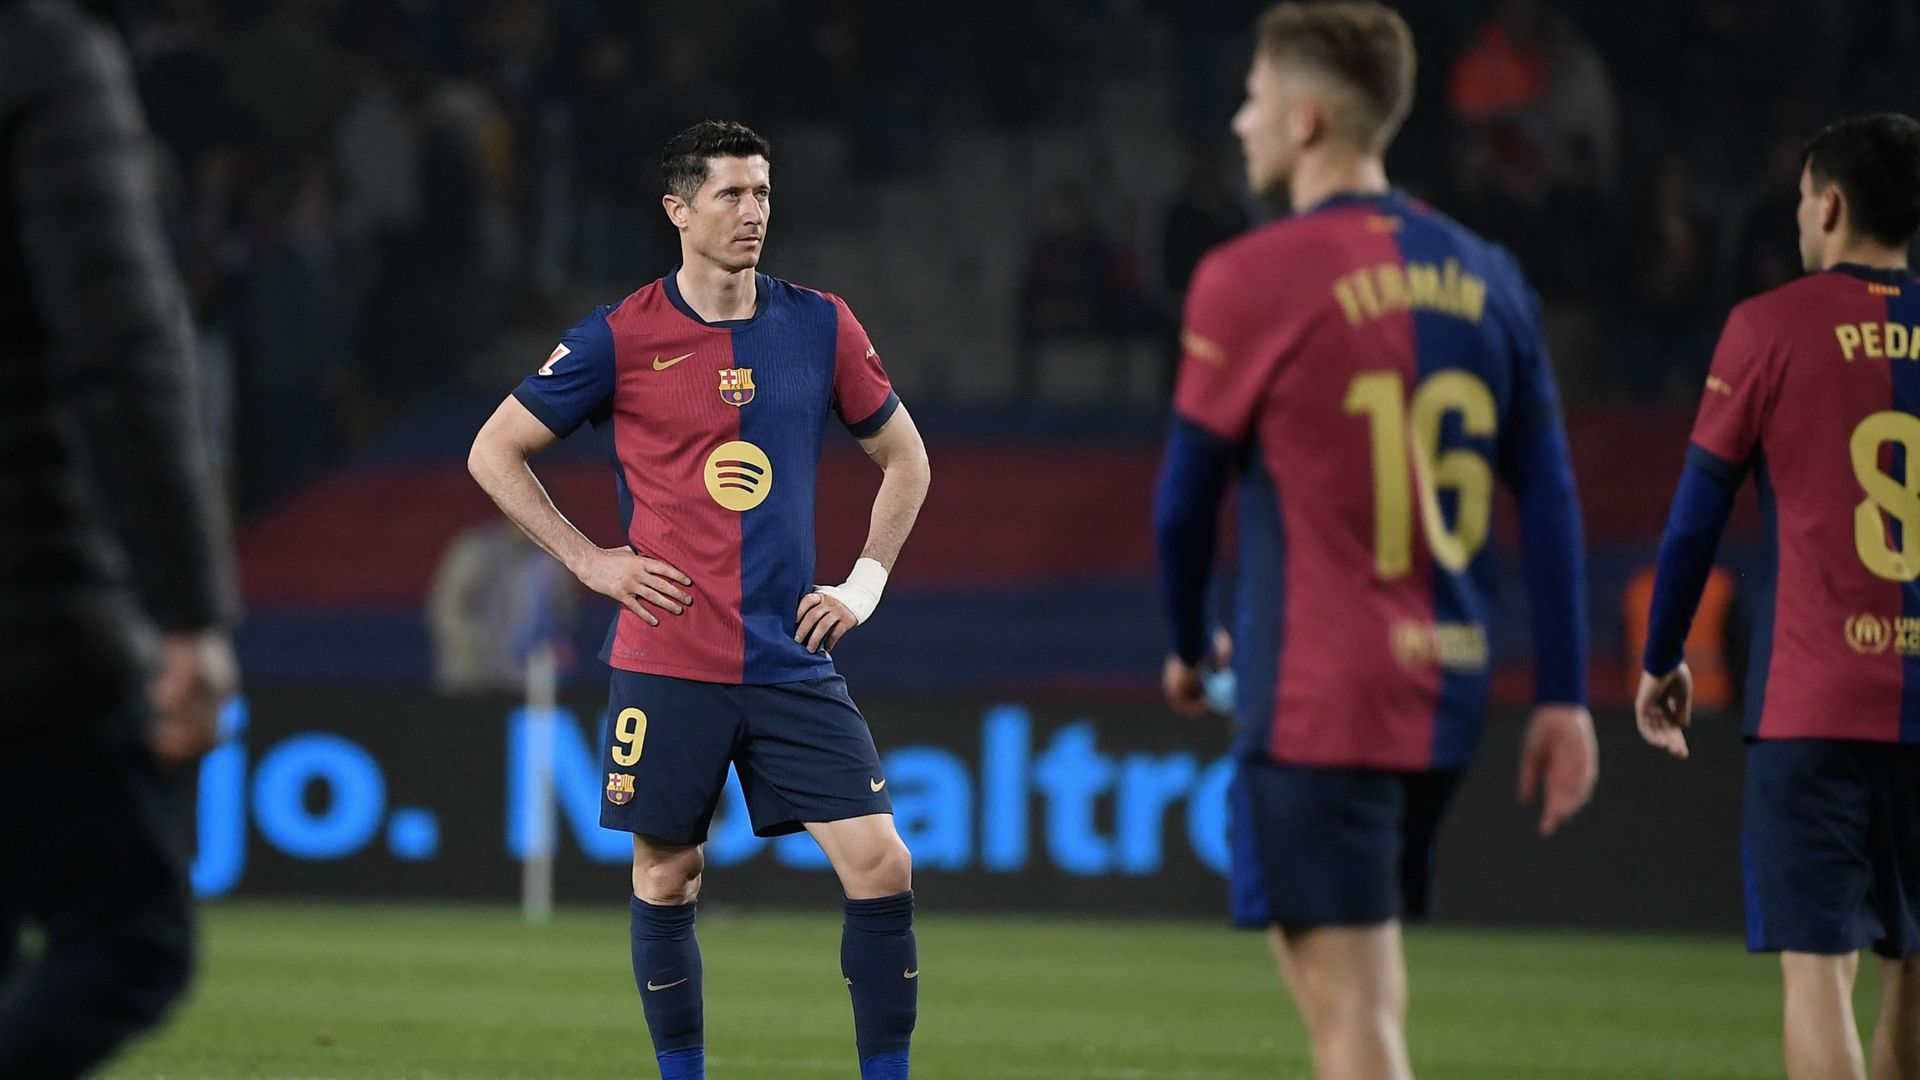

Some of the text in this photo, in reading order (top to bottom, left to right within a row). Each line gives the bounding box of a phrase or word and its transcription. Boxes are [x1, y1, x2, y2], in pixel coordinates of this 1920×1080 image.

[1342, 368, 1498, 581] 16
[1849, 410, 1920, 582] 8
[611, 707, 648, 767] 9
